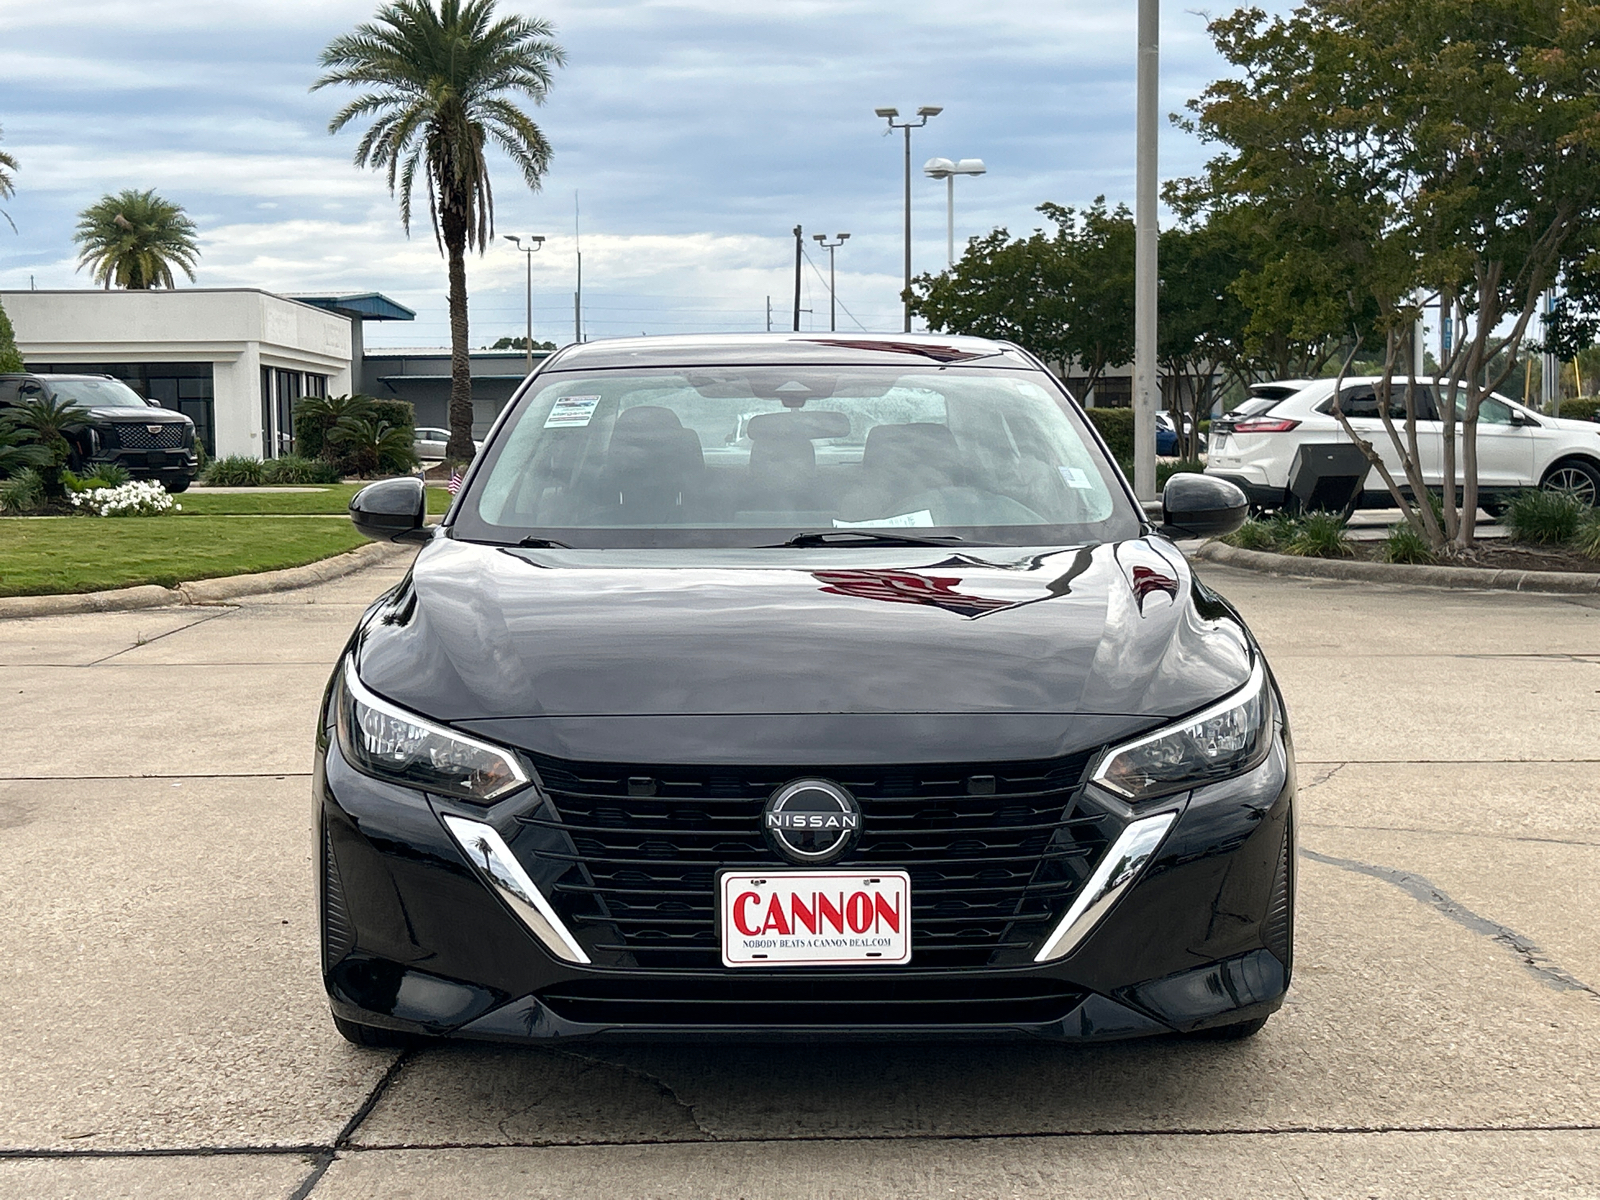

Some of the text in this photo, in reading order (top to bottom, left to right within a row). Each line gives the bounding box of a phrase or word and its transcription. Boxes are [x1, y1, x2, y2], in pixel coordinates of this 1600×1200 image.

[768, 814, 857, 827] NISSAN
[733, 891, 900, 936] CANNON
[742, 938, 891, 948] NOBODY BEATS A CANNON DEAL.COM
